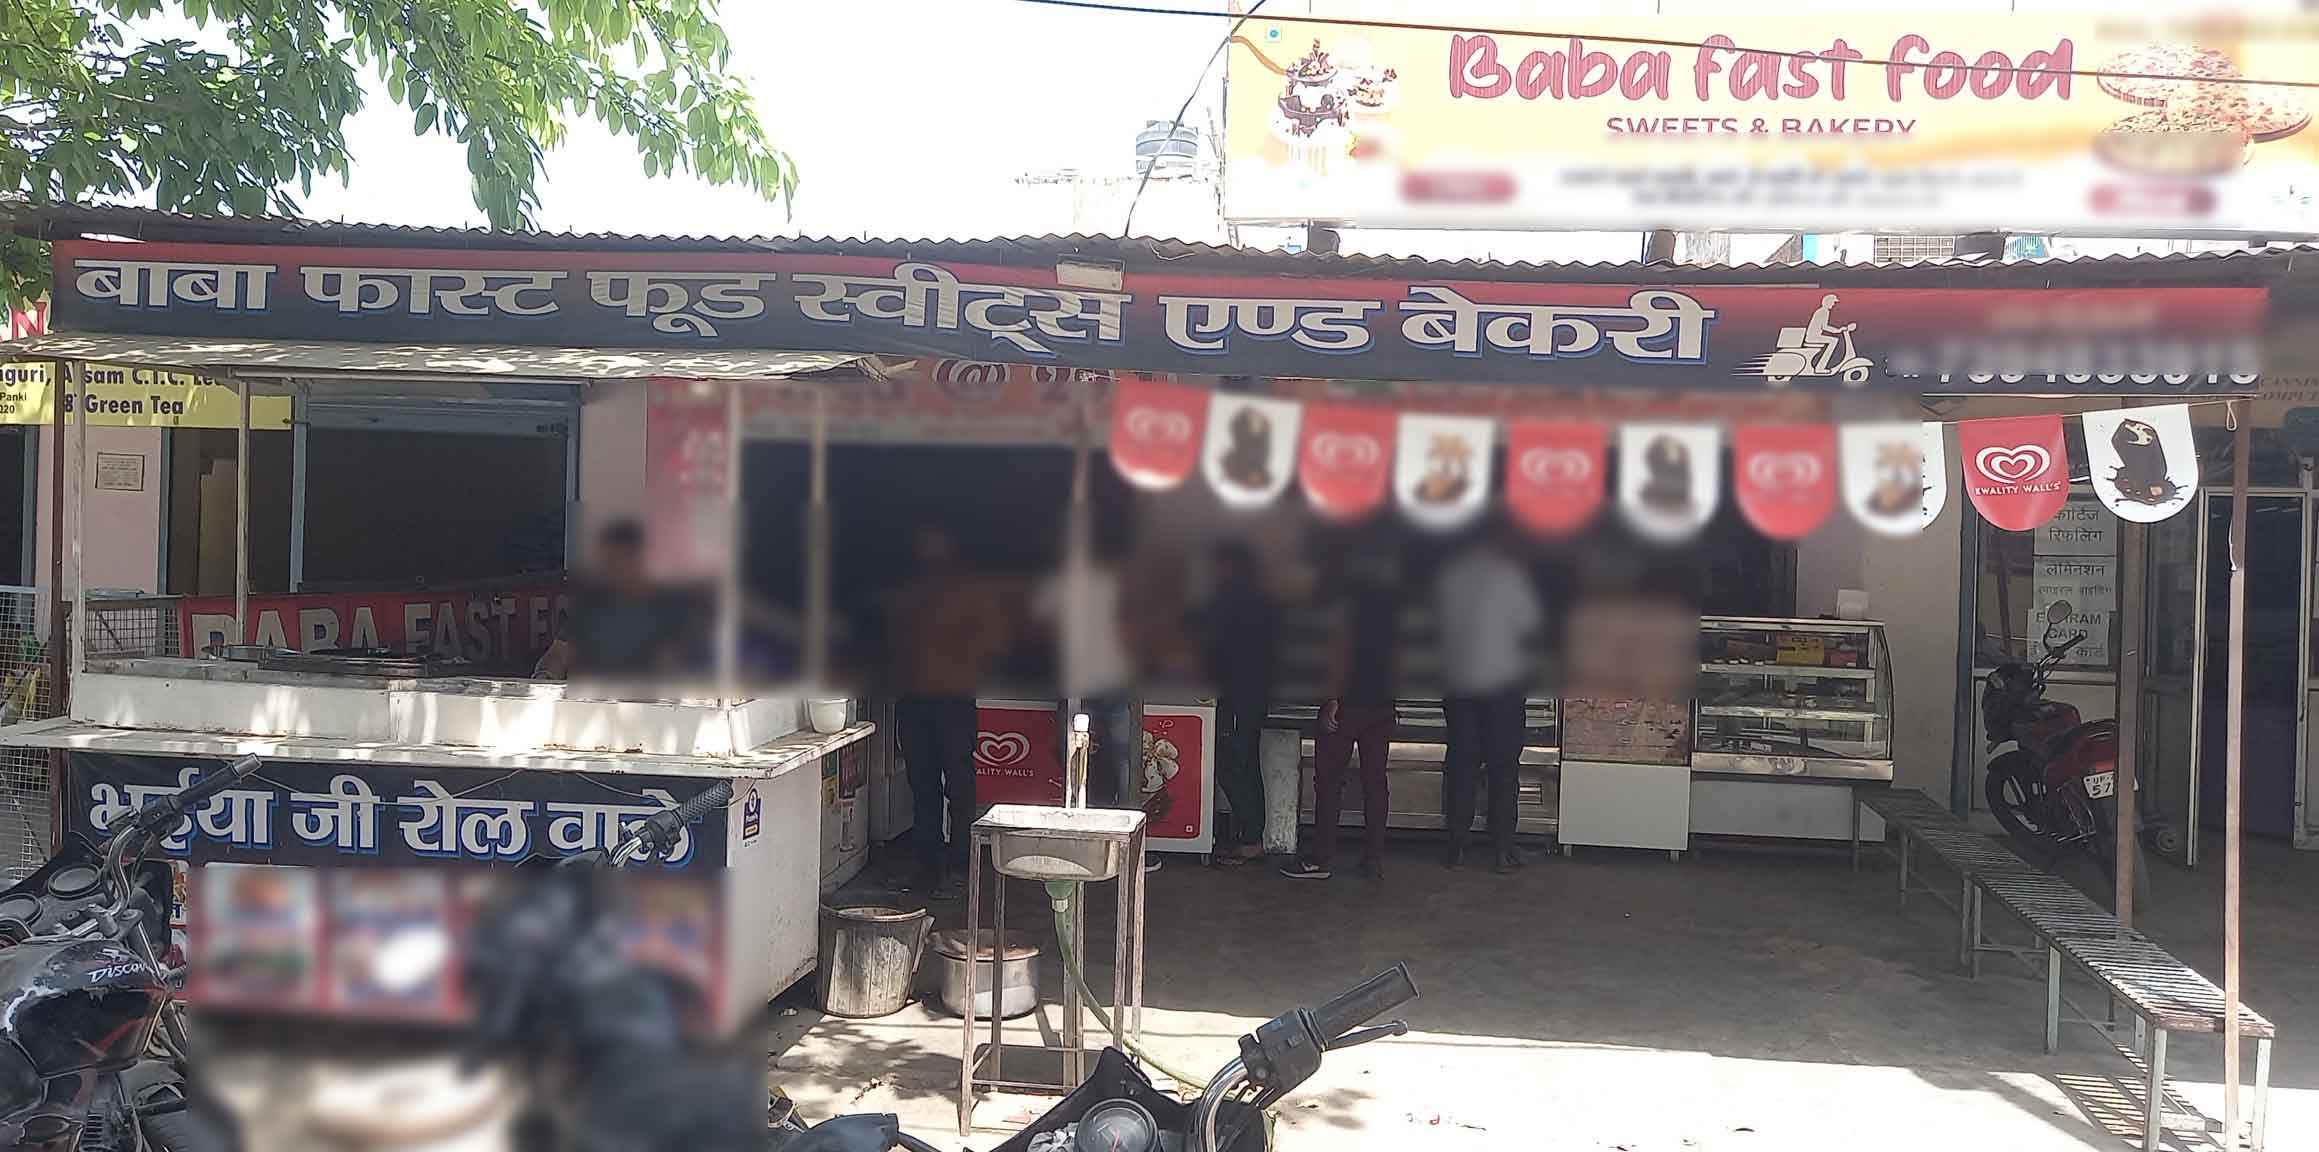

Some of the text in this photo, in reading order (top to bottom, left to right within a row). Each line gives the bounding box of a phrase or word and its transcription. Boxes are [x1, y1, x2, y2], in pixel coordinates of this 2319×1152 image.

[1449, 34, 1669, 100] Baba
[74, 258, 1716, 360] बाबा फास्ट फूड स्वीट्स एण्ड बेकरी
[85, 393, 143, 414] Green
[150, 395, 184, 414] Tea
[1974, 481, 2061, 496] KWALITY WALL'S
[290, 774, 381, 849] जी
[396, 780, 535, 854] रोल
